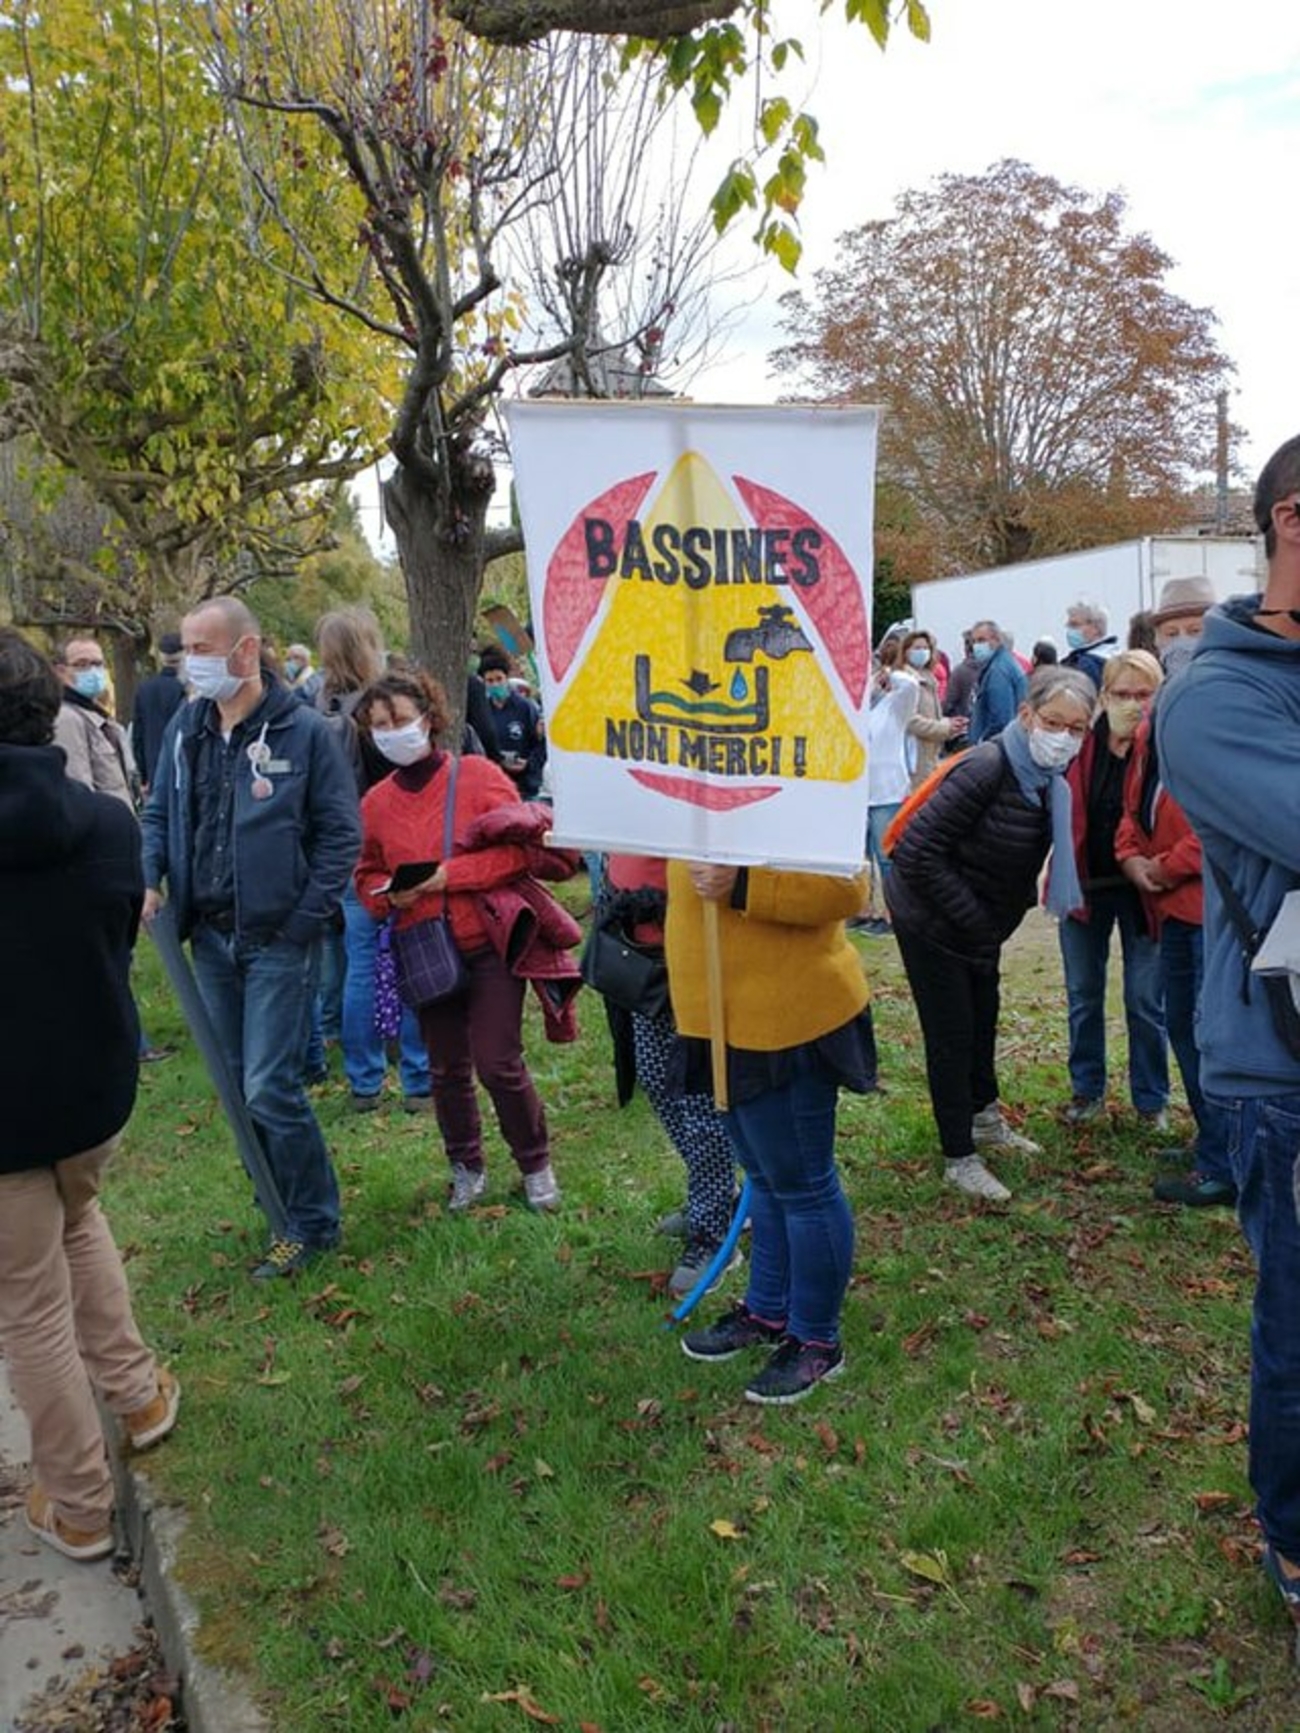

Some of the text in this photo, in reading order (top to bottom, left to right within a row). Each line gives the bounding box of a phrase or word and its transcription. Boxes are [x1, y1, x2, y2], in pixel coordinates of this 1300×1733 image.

[584, 518, 821, 588] BASSINES
[605, 719, 668, 765] NON
[679, 731, 781, 776] MERCI
